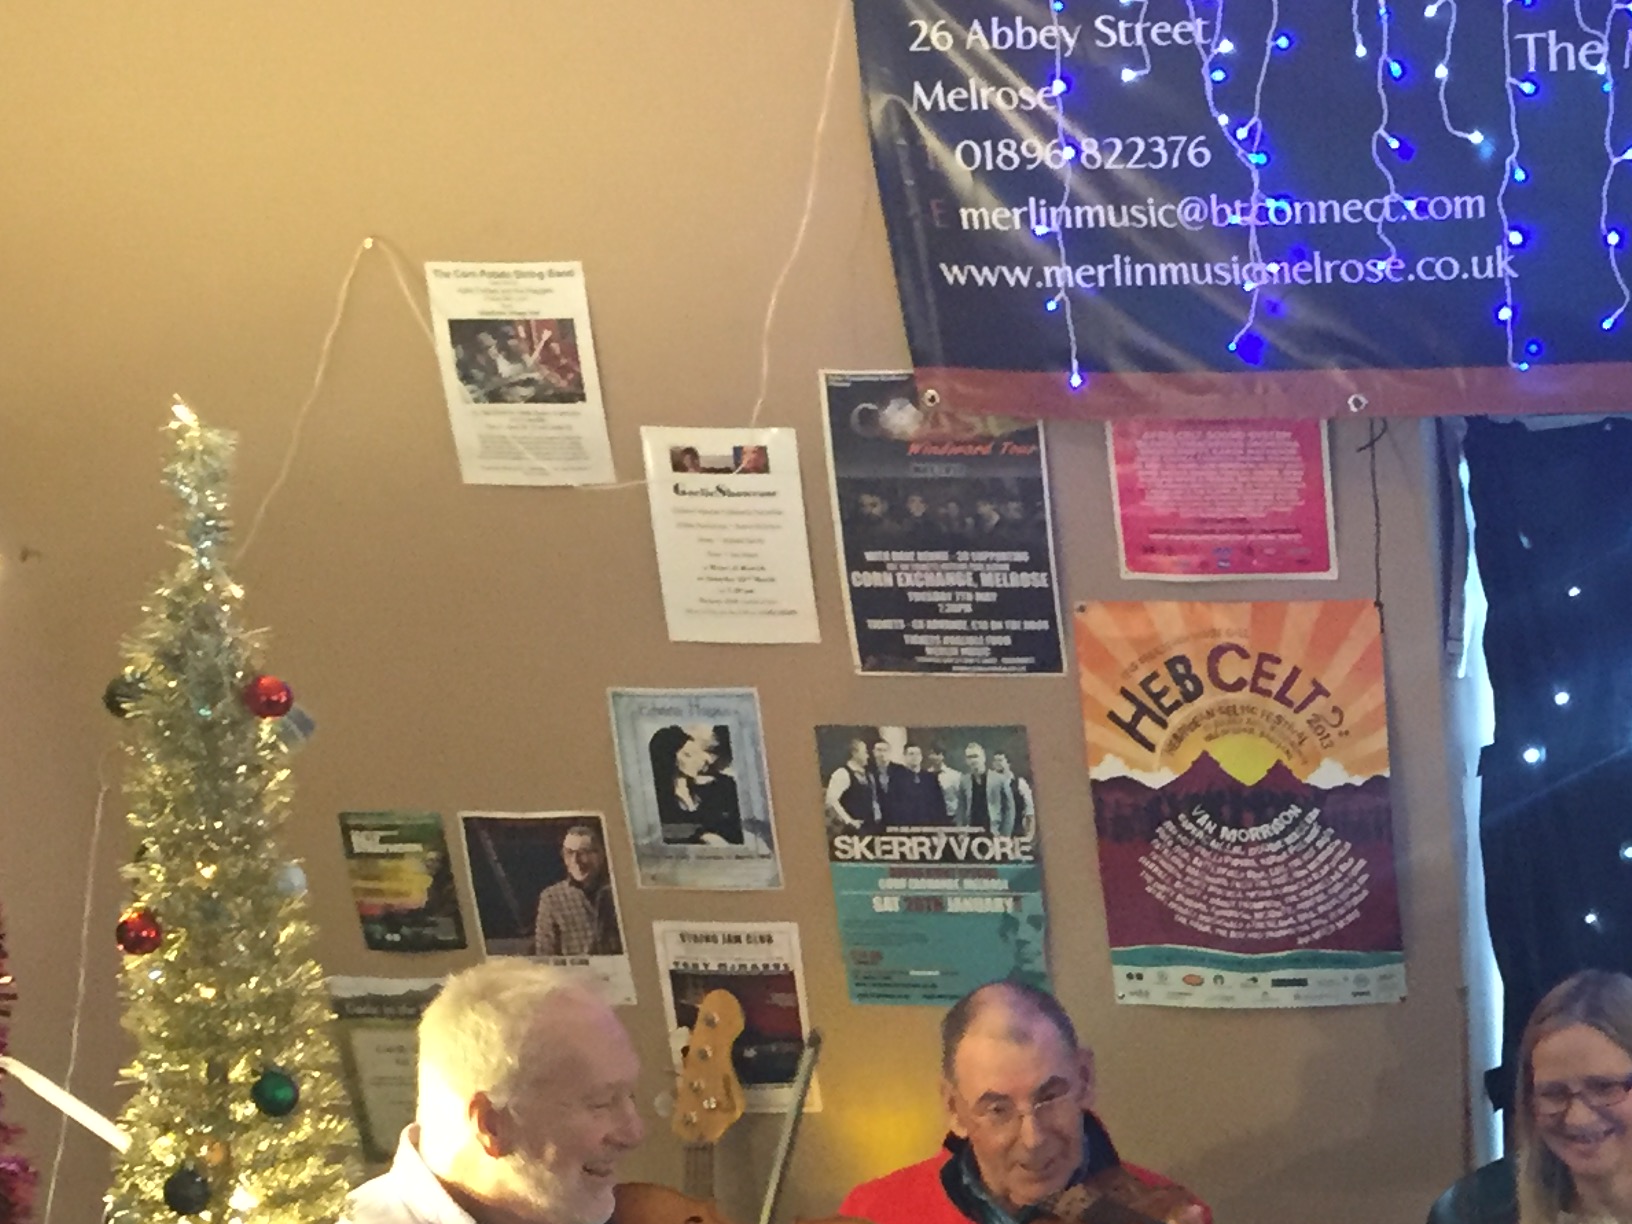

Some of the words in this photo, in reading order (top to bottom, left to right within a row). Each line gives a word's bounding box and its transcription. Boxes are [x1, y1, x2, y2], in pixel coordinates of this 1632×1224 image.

[908, 19, 954, 52] 26
[965, 15, 1079, 57] Abbey
[1094, 14, 1212, 48] Street
[1515, 30, 1604, 72] The
[911, 80, 1056, 113] Melrose
[955, 138, 1068, 172] 01896
[1080, 136, 1212, 170] 822376
[959, 191, 1486, 232] merlinmusic@btconnect.com
[1191, 803, 1218, 835] VAN
[1219, 803, 1303, 843] MORRISON
[833, 835, 1035, 861] SKERRYVORE
